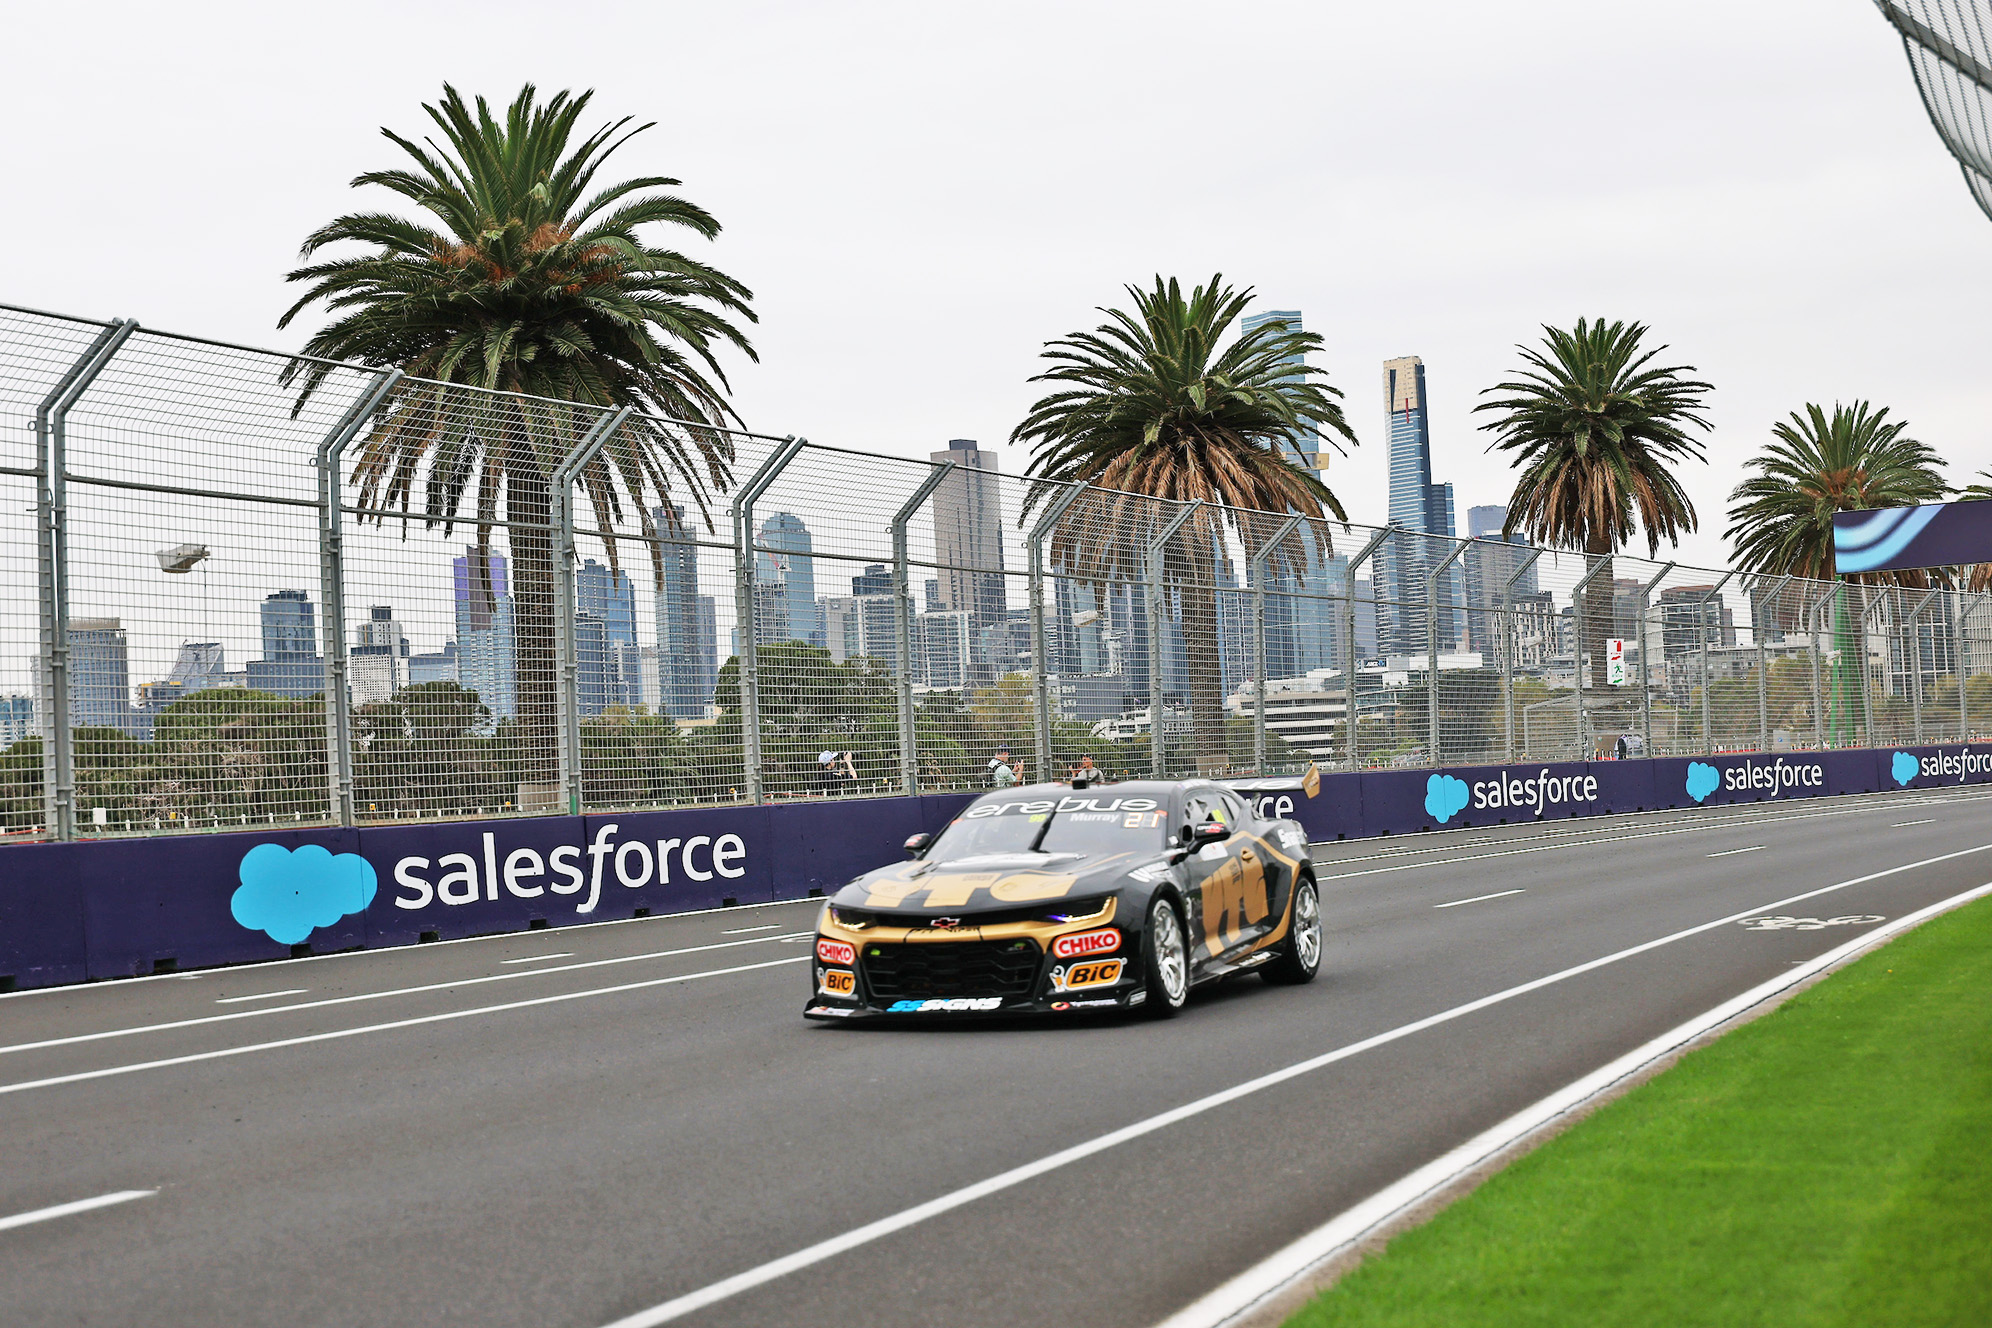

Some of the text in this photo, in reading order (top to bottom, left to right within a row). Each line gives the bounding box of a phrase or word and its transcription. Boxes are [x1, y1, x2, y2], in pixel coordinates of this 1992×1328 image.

[1725, 757, 1824, 797] salesforce
[1921, 747, 1992, 782] salesforc
[1473, 768, 1599, 816] salesforce
[966, 796, 1158, 819] erebus
[1070, 812, 1119, 823] Murray
[394, 824, 746, 914] salesforce
[820, 943, 852, 961] CHIKO
[1058, 933, 1117, 954] CHIKO
